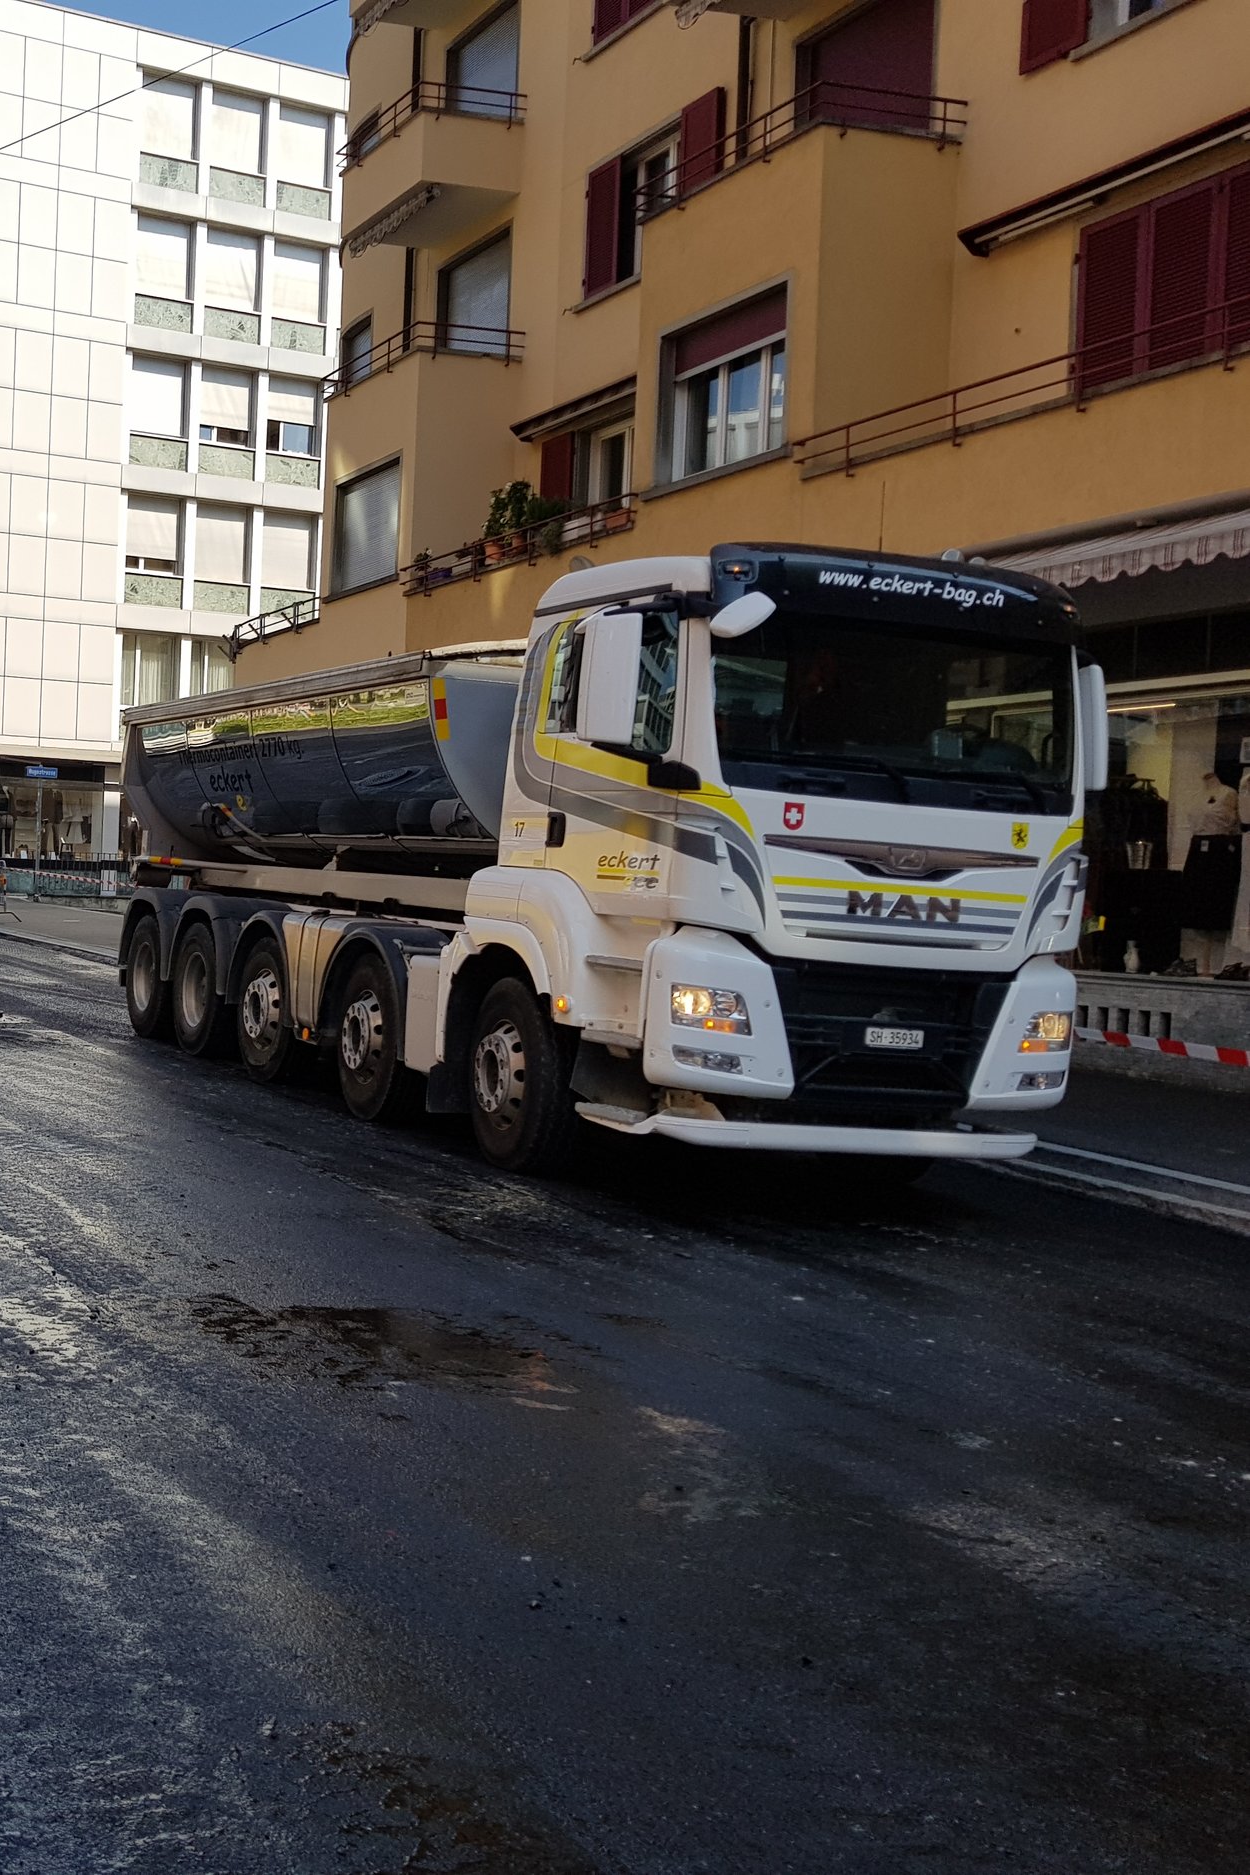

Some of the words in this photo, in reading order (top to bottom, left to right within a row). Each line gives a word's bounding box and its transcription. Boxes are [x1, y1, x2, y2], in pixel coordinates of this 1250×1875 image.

[818, 570, 1005, 607] www.eckert-bag.ch
[210, 765, 254, 793] eckert
[514, 822, 525, 838] 17
[598, 851, 660, 870] eckert
[846, 890, 961, 923] MAN
